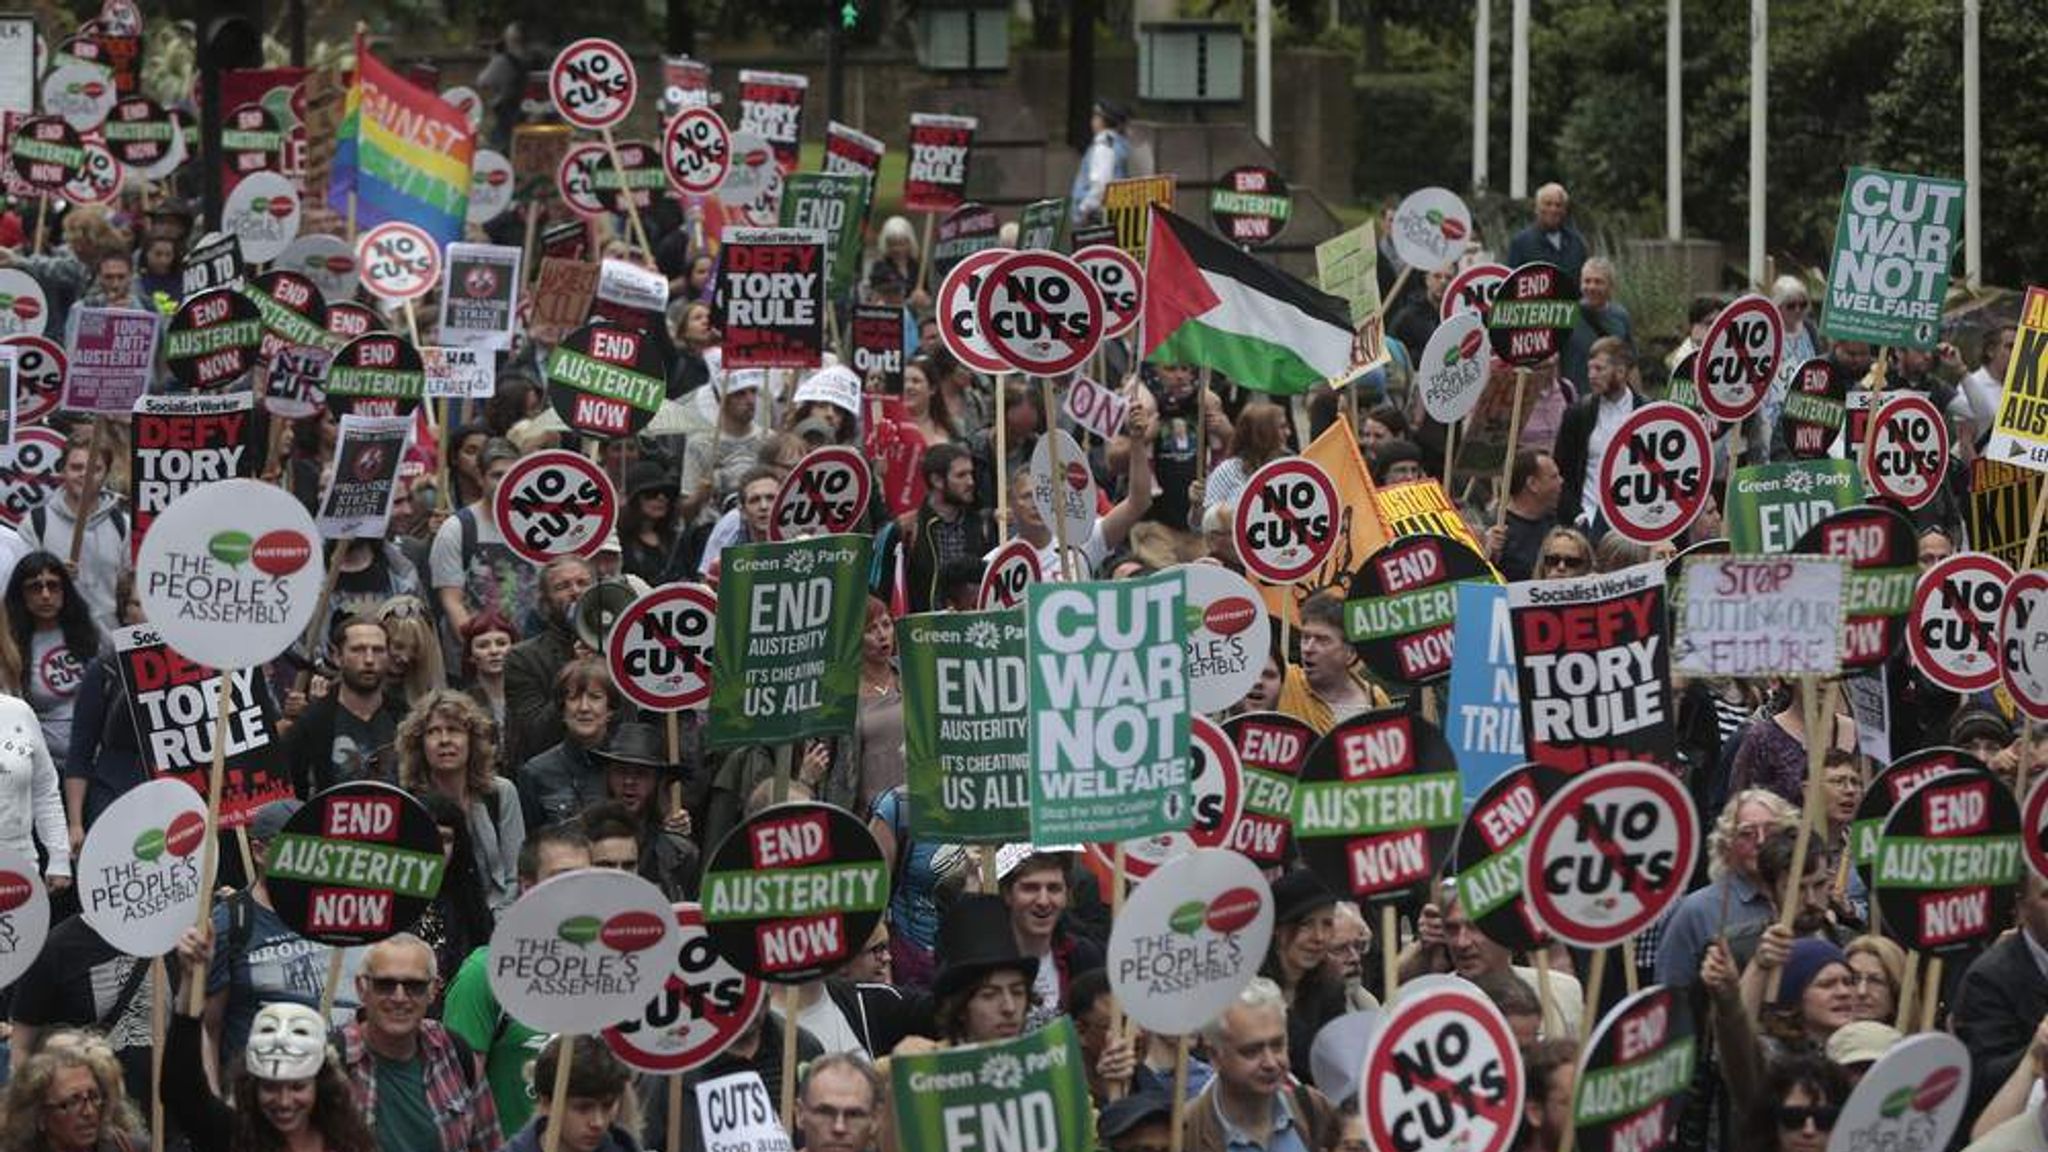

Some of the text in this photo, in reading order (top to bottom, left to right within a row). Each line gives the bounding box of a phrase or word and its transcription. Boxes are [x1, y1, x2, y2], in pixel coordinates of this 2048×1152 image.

[567, 55, 608, 81] NO
[565, 74, 627, 107] CUTS
[122, 103, 148, 120] END
[741, 102, 800, 123] TORY
[37, 124, 64, 139] END
[677, 122, 709, 150] NO
[740, 120, 797, 142] RULE
[126, 142, 157, 159] NOW
[676, 140, 723, 175] CUTS
[910, 145, 968, 165] TORY
[29, 165, 63, 182] NOW
[908, 163, 964, 183] RULE
[1235, 172, 1266, 191] END
[795, 198, 845, 229] END
[1212, 191, 1288, 219] AUSTERITY
[1851, 174, 1960, 224] CUT
[1233, 218, 1269, 237] NOW
[1847, 213, 1951, 262] WAR
[374, 237, 415, 257] NO
[730, 250, 816, 271] DEFY
[184, 253, 236, 293] NO TO
[369, 256, 430, 281] CUTS
[1833, 250, 1945, 300] NOT
[275, 278, 309, 306] END
[728, 273, 816, 299] TORY
[1006, 276, 1070, 303] NO
[1518, 274, 1550, 297] END
[194, 300, 229, 326] END
[728, 300, 815, 326] RULE
[1491, 302, 1575, 325] AUSTERITY
[1832, 289, 1938, 321] WELFARE
[168, 322, 262, 354] AUSTERITY
[330, 313, 367, 334] END
[992, 311, 1089, 339] CUTS
[1724, 320, 1769, 349] NO
[360, 346, 395, 365] END
[446, 352, 477, 366] WAR
[593, 332, 635, 359] END
[854, 348, 900, 373] Out!
[1511, 331, 1550, 357] NOW
[199, 352, 240, 379] NOW
[554, 354, 660, 406] AUSTERITY
[1706, 354, 1771, 386] CUTS
[1803, 368, 1829, 392] END
[330, 371, 421, 396] AUSTERITY
[146, 399, 198, 413] Socialist
[354, 402, 397, 418] NOW
[577, 400, 627, 427] NOW
[1070, 379, 1128, 439] ON
[138, 415, 245, 449] DEFY
[1795, 426, 1824, 450] NOW
[1888, 418, 1931, 443] NO
[138, 446, 245, 481] TORY
[1629, 429, 1686, 466] NO
[1876, 451, 1938, 476] CUTS
[512, 469, 567, 519] NO
[800, 470, 850, 494] NO
[1261, 481, 1315, 512] NO
[1611, 467, 1699, 507] CUTS
[1738, 473, 1851, 493] Green Party
[525, 481, 603, 550] CUTS
[779, 501, 853, 527] CUTS
[1759, 499, 1834, 553] END
[1248, 515, 1329, 550] CUTS
[1827, 525, 1884, 560] END
[166, 552, 213, 575] THE
[732, 548, 857, 572] Green Party
[1382, 547, 1438, 591] END
[149, 570, 290, 605] PEOPLE'S
[992, 565, 1028, 603] NO
[1529, 571, 1649, 603] Socialist Worker
[1716, 560, 1794, 596] STOP
[179, 601, 292, 624] ASSEMBLY
[750, 576, 832, 633] END
[1942, 579, 2003, 613] NO
[641, 608, 708, 640] NO
[1037, 581, 1183, 654] CUT
[1522, 592, 1657, 653] DEFY
[749, 629, 827, 656] AUSTERITY
[911, 628, 961, 643] Green
[1921, 618, 1996, 651] CUT
[50, 650, 77, 672] NO
[1402, 631, 1456, 673] NOW
[1523, 634, 1660, 698] TORY
[1707, 636, 1823, 674] FUTURE
[745, 660, 826, 683] IT'S CHEATING
[937, 657, 1027, 715] END
[1038, 644, 1186, 709] WAR
[138, 668, 254, 732] TORY
[743, 680, 823, 716] US ALL
[1531, 678, 1665, 741] RULE
[150, 706, 270, 771] RULE
[939, 717, 1028, 743] AUSTERITY
[1037, 699, 1184, 771] NOT
[941, 753, 1029, 772] IT'S CHEATING
[1241, 728, 1300, 766] END
[1342, 727, 1408, 777] END
[942, 776, 1029, 811] US ALL
[1039, 758, 1187, 799] WELFARE
[329, 802, 393, 835] END
[1302, 780, 1460, 831] AUSTERITY
[1480, 785, 1537, 848] END
[1574, 800, 1659, 842] NO
[1928, 790, 1986, 834] END
[756, 822, 823, 867] END
[1353, 833, 1425, 886] NOW
[100, 862, 142, 885] THE
[274, 839, 437, 892] AUSTERITY
[1543, 850, 1674, 895] CUTS
[1881, 842, 2018, 882] AUSTERITY
[92, 857, 199, 911] PEOPLE'S
[123, 878, 202, 922] ASSEMBLY
[709, 869, 880, 915] AUSTERITY
[312, 894, 388, 927] NOW
[1924, 891, 1987, 940] NOW
[516, 938, 563, 955] THE
[762, 918, 838, 966] NOW
[1131, 935, 1175, 951] THE
[498, 953, 639, 979] PEOPLE'S
[1120, 936, 1240, 984] PEOPLE'S
[1149, 955, 1243, 998] ASSEMBLY
[526, 976, 641, 995] ASSEMBLY
[645, 978, 745, 1027] UTS
[1621, 1005, 1667, 1060] END
[909, 1045, 1068, 1091] Green Party
[1392, 1023, 1468, 1093] NO
[1578, 1044, 1688, 1119] AUSTERITY
[708, 1081, 766, 1134] CUTS
[943, 1091, 1058, 1152] END
[1392, 1060, 1507, 1152] CUTS
[1611, 1104, 1664, 1152] NOW
